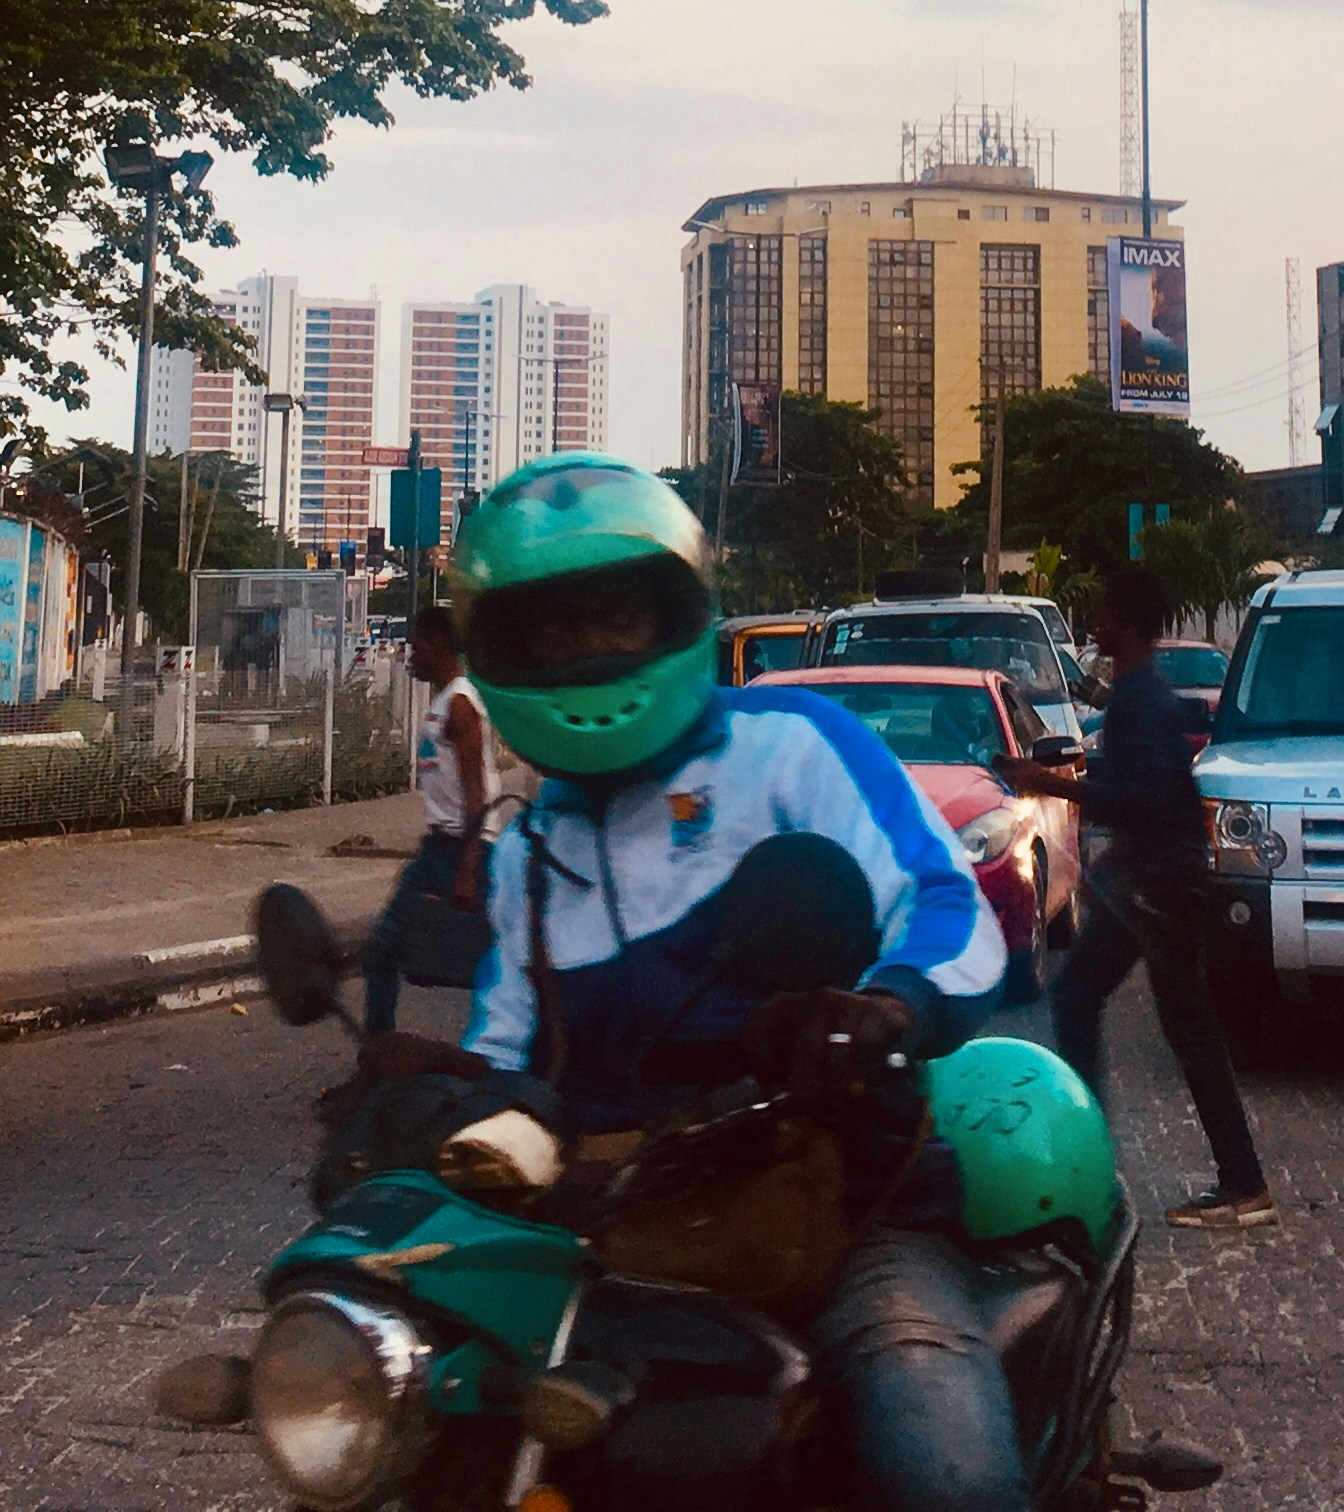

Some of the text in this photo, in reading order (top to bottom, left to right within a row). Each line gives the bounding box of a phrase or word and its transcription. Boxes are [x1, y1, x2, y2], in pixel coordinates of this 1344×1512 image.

[1123, 246, 1181, 268] IMAX
[1122, 370, 1152, 387] LION
[1149, 390, 1174, 399] JULY
